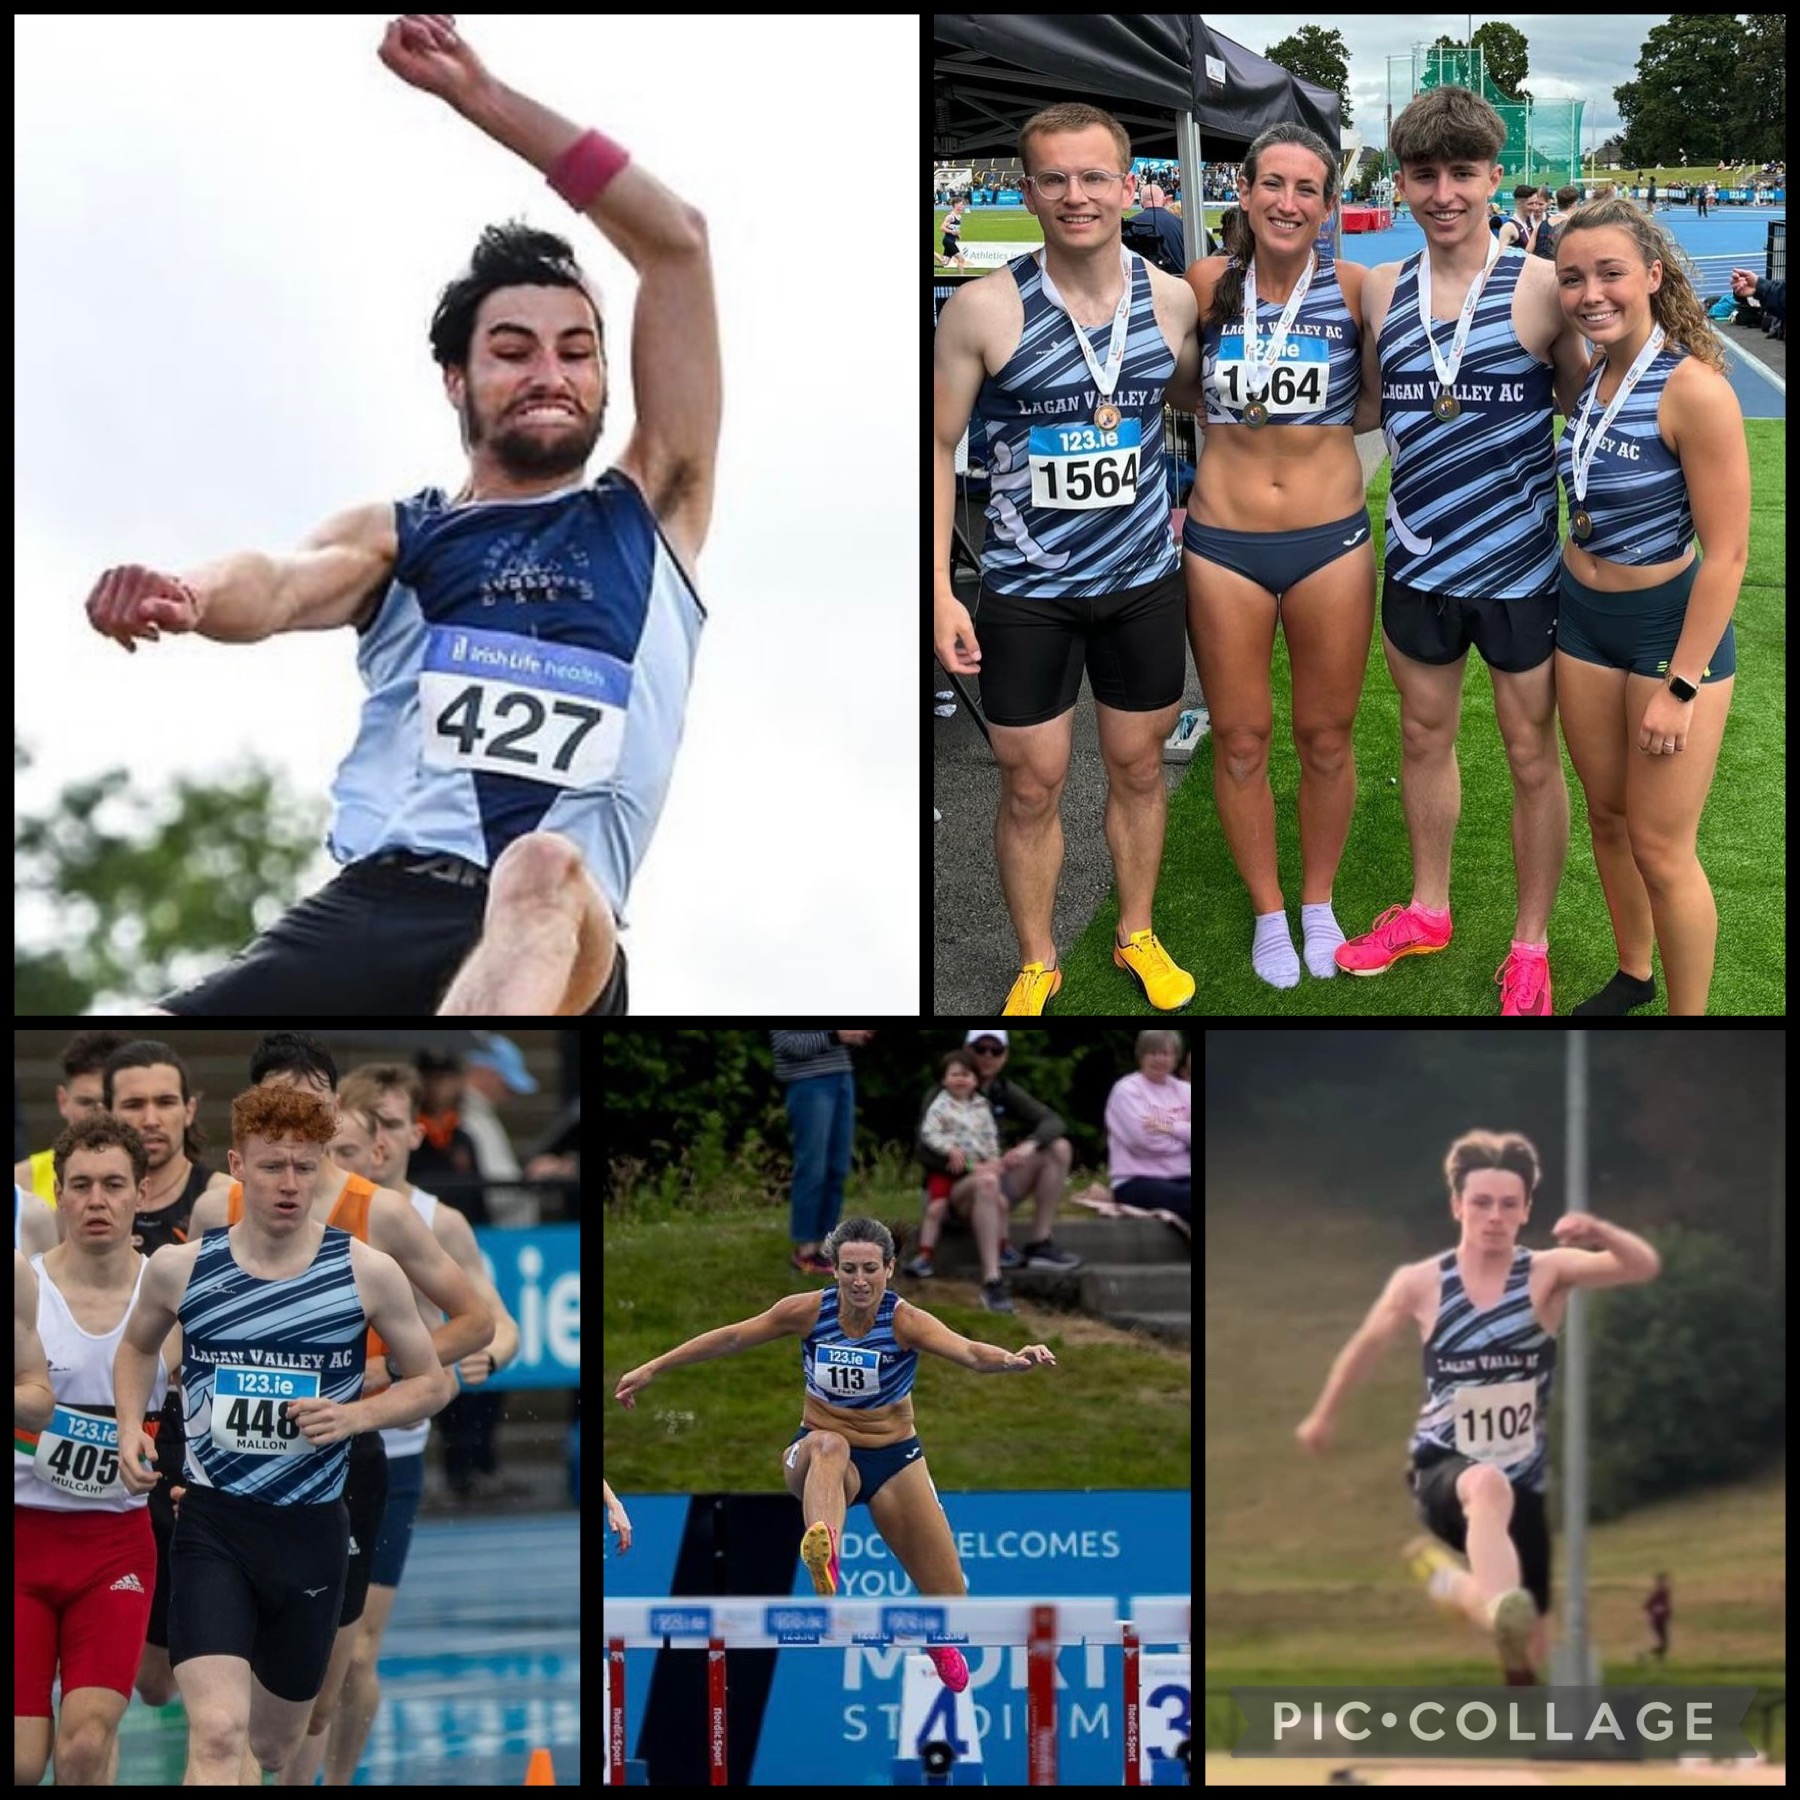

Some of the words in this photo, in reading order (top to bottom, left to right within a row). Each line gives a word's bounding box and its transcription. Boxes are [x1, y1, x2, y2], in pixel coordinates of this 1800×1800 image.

[970, 251, 1008, 260] Athletics
[1221, 324, 1264, 336] LAGN
[1268, 322, 1321, 336] VLLEY
[1325, 325, 1343, 339] AC
[1382, 382, 1424, 401] LAGAN
[1499, 383, 1524, 402] AC
[1018, 395, 1080, 415] LAGAN
[1059, 430, 1119, 452] 123.ie
[1617, 441, 1640, 461] AC
[1039, 453, 1138, 501] 1564
[470, 648, 507, 667] Irish
[509, 653, 541, 673] Life
[436, 685, 603, 772] 427
[190, 1344, 244, 1365] LAGAN
[250, 1349, 325, 1368] VALLEY
[329, 1349, 352, 1369] AC
[828, 1350, 864, 1365] 123.ie
[237, 1373, 294, 1394] 123.ie
[828, 1366, 865, 1390] 113
[68, 1416, 118, 1443] 123.ie
[226, 1398, 300, 1440] 448
[1462, 1402, 1532, 1442] 1102
[237, 1439, 287, 1450] MALLON
[48, 1438, 119, 1486] 405
[51, 1475, 106, 1494] MULCAHY
[955, 1531, 1120, 1558] ELCOMES
[916, 1686, 969, 1754] 4
